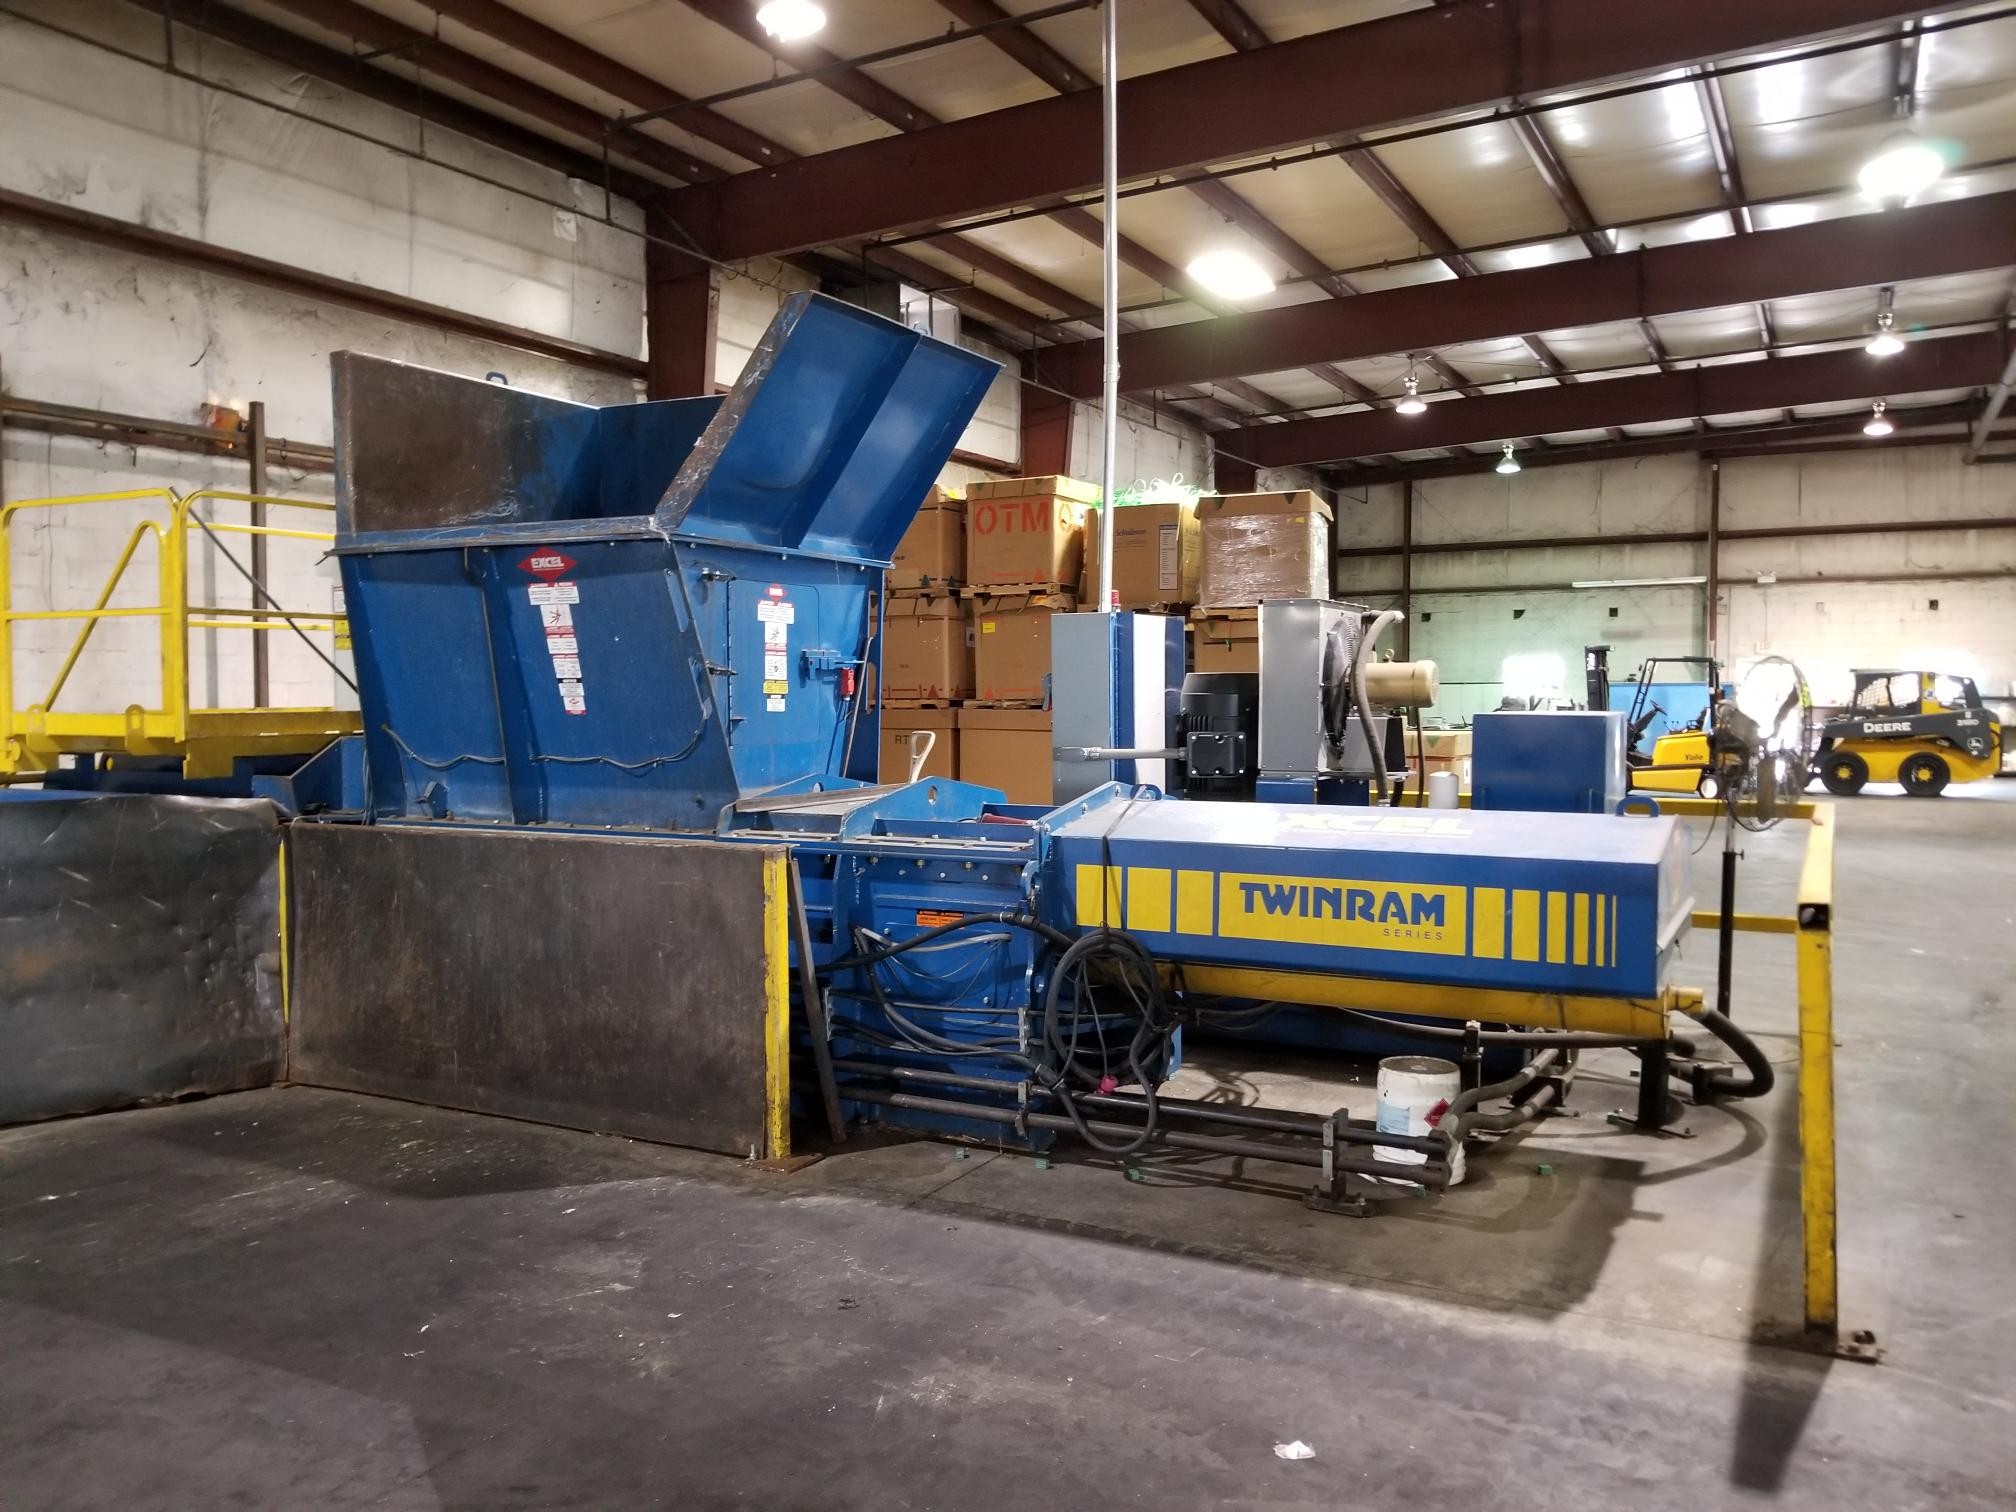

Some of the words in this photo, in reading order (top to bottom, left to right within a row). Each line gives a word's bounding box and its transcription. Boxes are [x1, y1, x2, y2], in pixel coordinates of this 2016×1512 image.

[974, 501, 1051, 535] OTM
[531, 556, 565, 569] EXCEL
[1863, 722, 1912, 733] DEERE
[1274, 812, 1475, 834] XCEL
[1239, 882, 1446, 927] TWINRAM
[1382, 928, 1443, 941] SERIES
